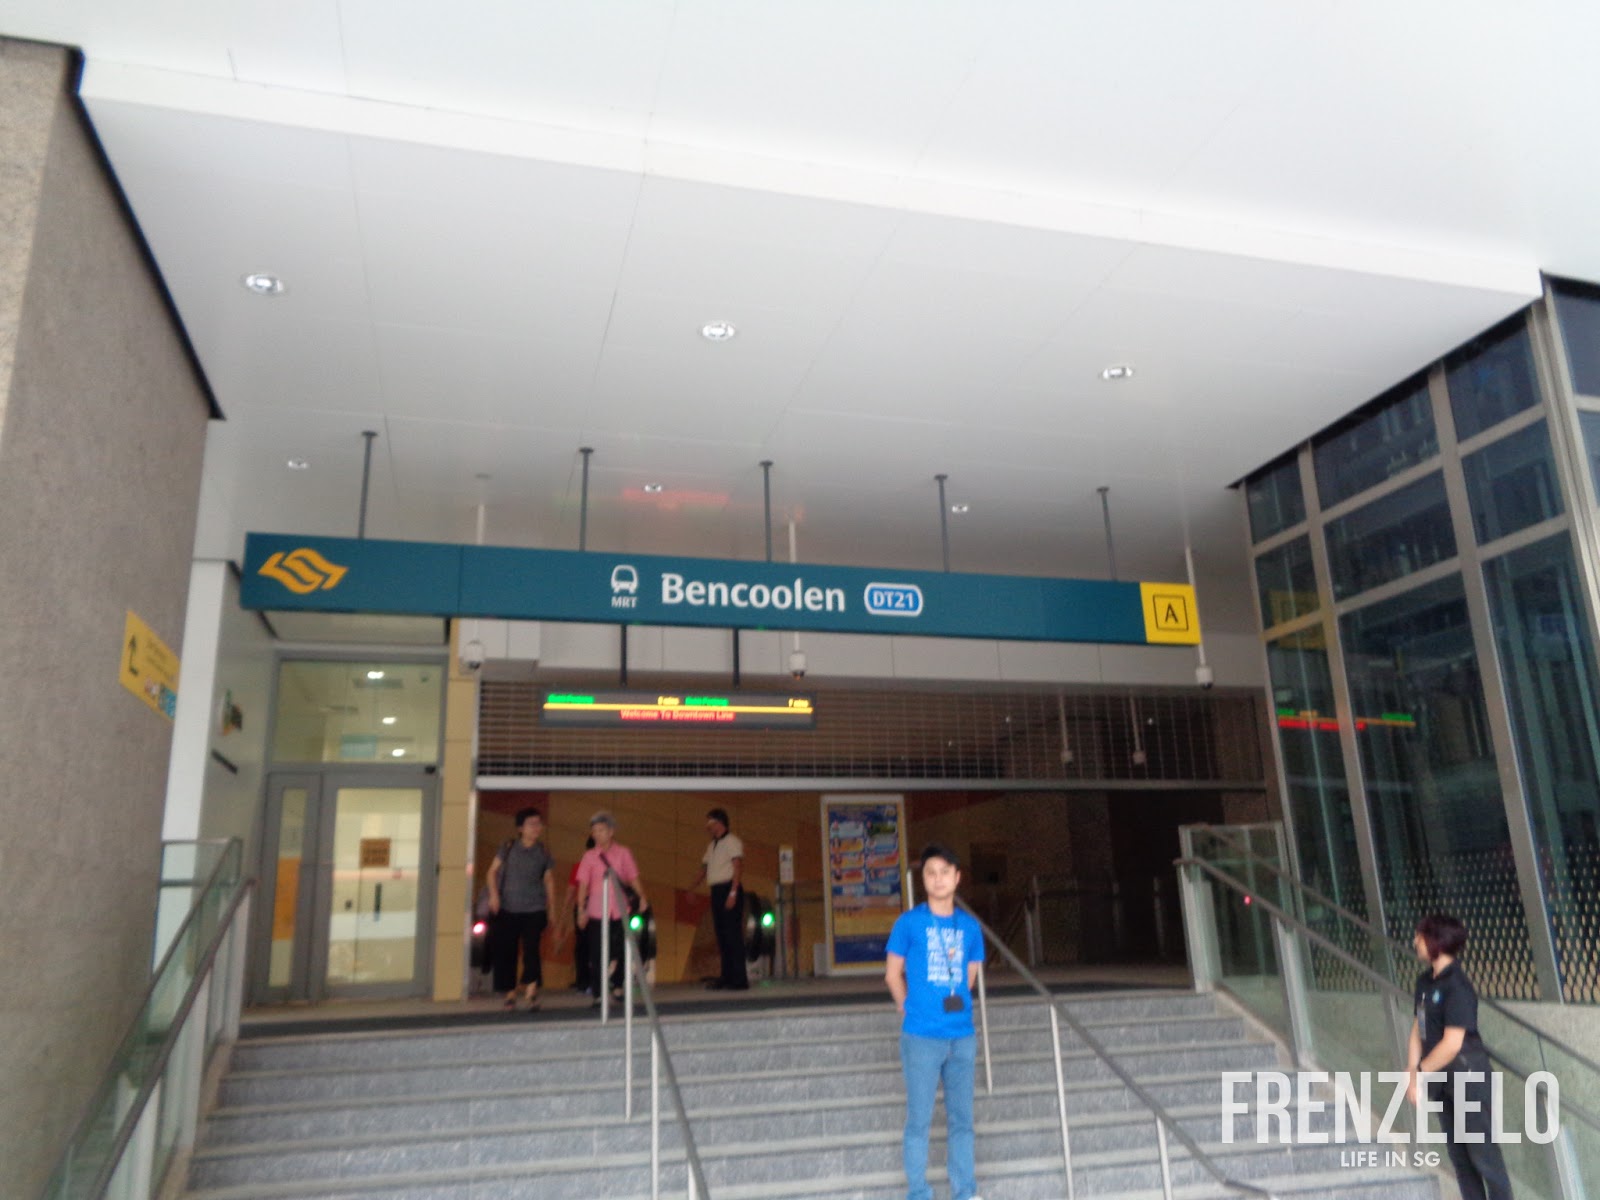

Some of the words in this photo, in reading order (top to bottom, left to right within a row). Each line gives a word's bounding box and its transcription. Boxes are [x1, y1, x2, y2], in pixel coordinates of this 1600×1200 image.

[611, 596, 637, 608] MRT
[661, 572, 846, 613] Bencoolen
[872, 590, 915, 609] DT21
[1165, 603, 1178, 623] A
